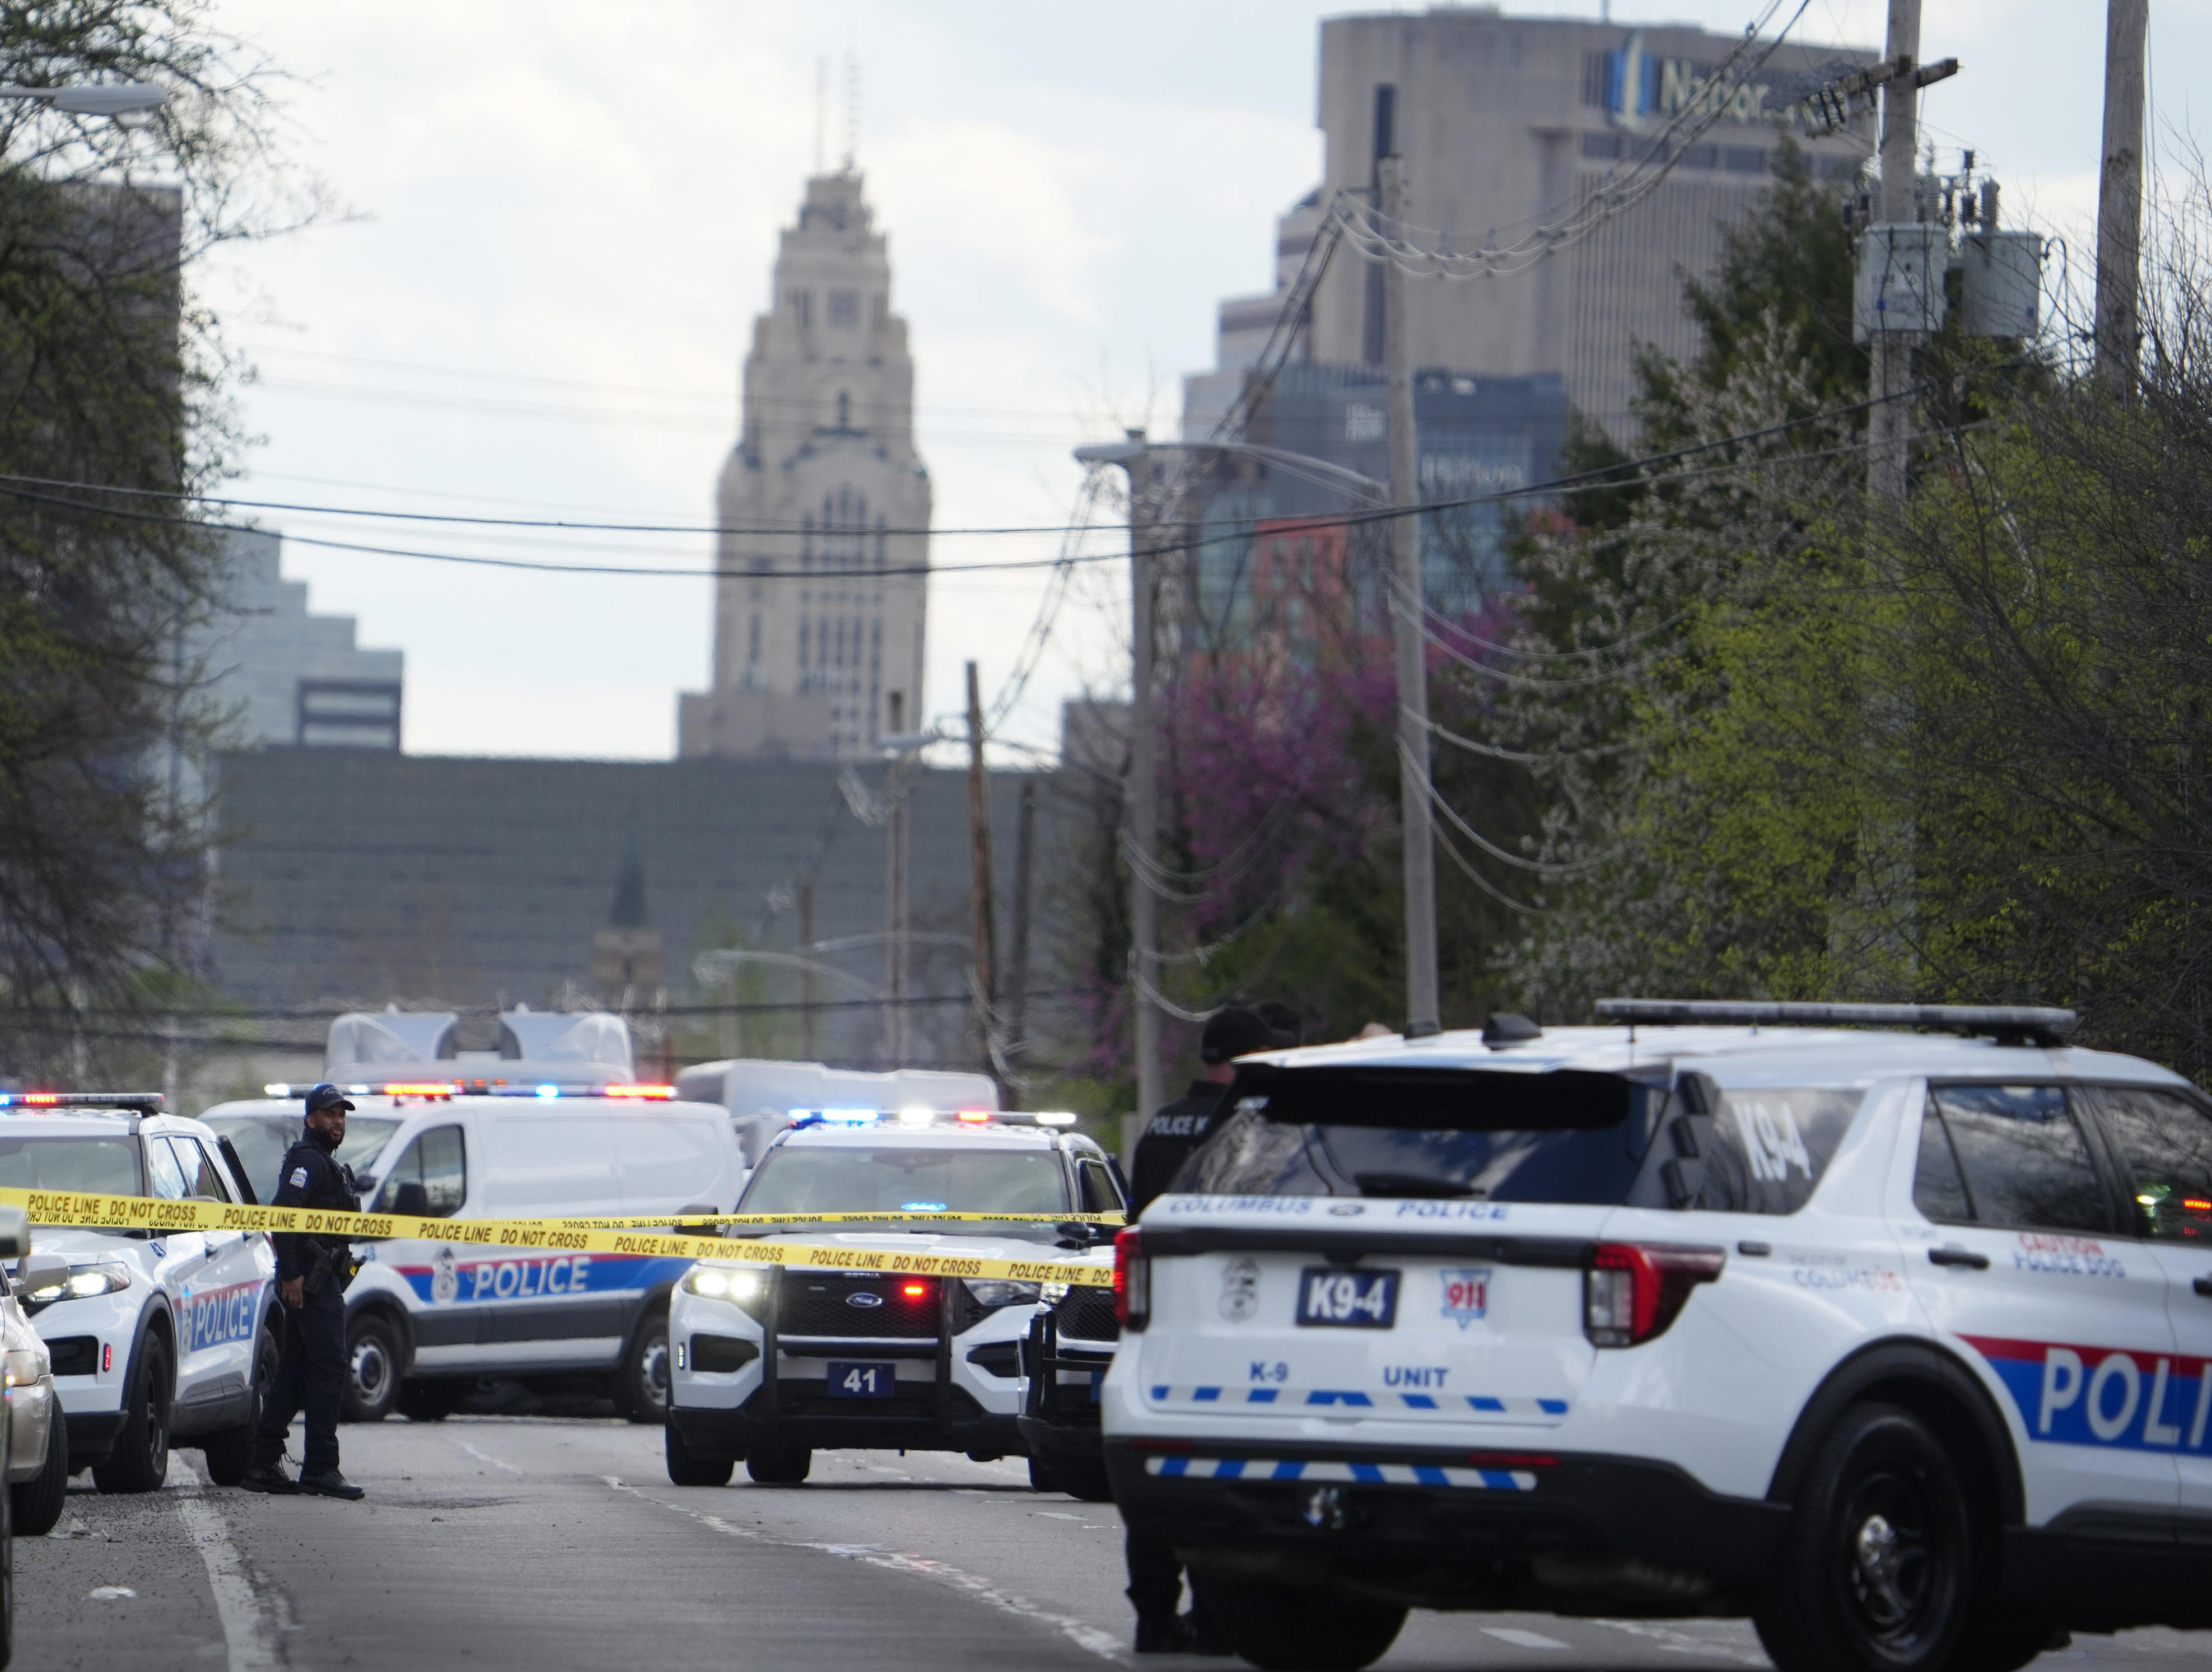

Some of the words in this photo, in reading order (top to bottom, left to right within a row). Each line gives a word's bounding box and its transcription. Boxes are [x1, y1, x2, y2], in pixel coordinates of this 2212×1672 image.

[29, 1194, 69, 1212] POLICE
[73, 1199, 100, 1214] LINE
[110, 1201, 126, 1216] DO
[130, 1202, 154, 1218] NOT
[157, 1204, 196, 1221] CROSS
[1169, 1196, 1313, 1215] COLUMBUS
[1397, 1201, 1510, 1219] POLICE
[224, 1209, 265, 1226] POLICE
[269, 1212, 296, 1228] LINE
[306, 1215, 322, 1230] DO
[325, 1216, 351, 1232] NOT
[353, 1218, 393, 1235] CROSS
[419, 1223, 461, 1240] POLICE
[464, 1226, 492, 1242] LINE
[501, 1229, 517, 1244] DO
[520, 1230, 546, 1246] NOT
[548, 1232, 588, 1249] CROSS
[614, 1236, 659, 1254] POLICE
[661, 1240, 688, 1255] LINE
[696, 1243, 713, 1257] DO
[716, 1244, 741, 1259] NOT
[744, 1246, 784, 1261] CROSS
[2018, 1233, 2104, 1256] CAUTION
[810, 1250, 853, 1266] POLICE
[855, 1253, 884, 1268] LINE
[892, 1256, 909, 1270] DO
[913, 1258, 939, 1272] NOT
[941, 1259, 981, 1275] CROSS
[1008, 1263, 1053, 1280] POLICE
[1055, 1267, 1084, 1282] LINE
[1092, 1269, 1110, 1283] DO
[2013, 1251, 2082, 1274] POLICE
[2083, 1257, 2126, 1278] DOG
[473, 1256, 590, 1300] POLICE
[1306, 1273, 1385, 1320] K9-4
[1447, 1281, 1486, 1309] 911
[194, 1286, 249, 1346] POLICE
[843, 1368, 875, 1393] 41
[1249, 1361, 1290, 1383] K-9
[1383, 1365, 1449, 1388] UNIT
